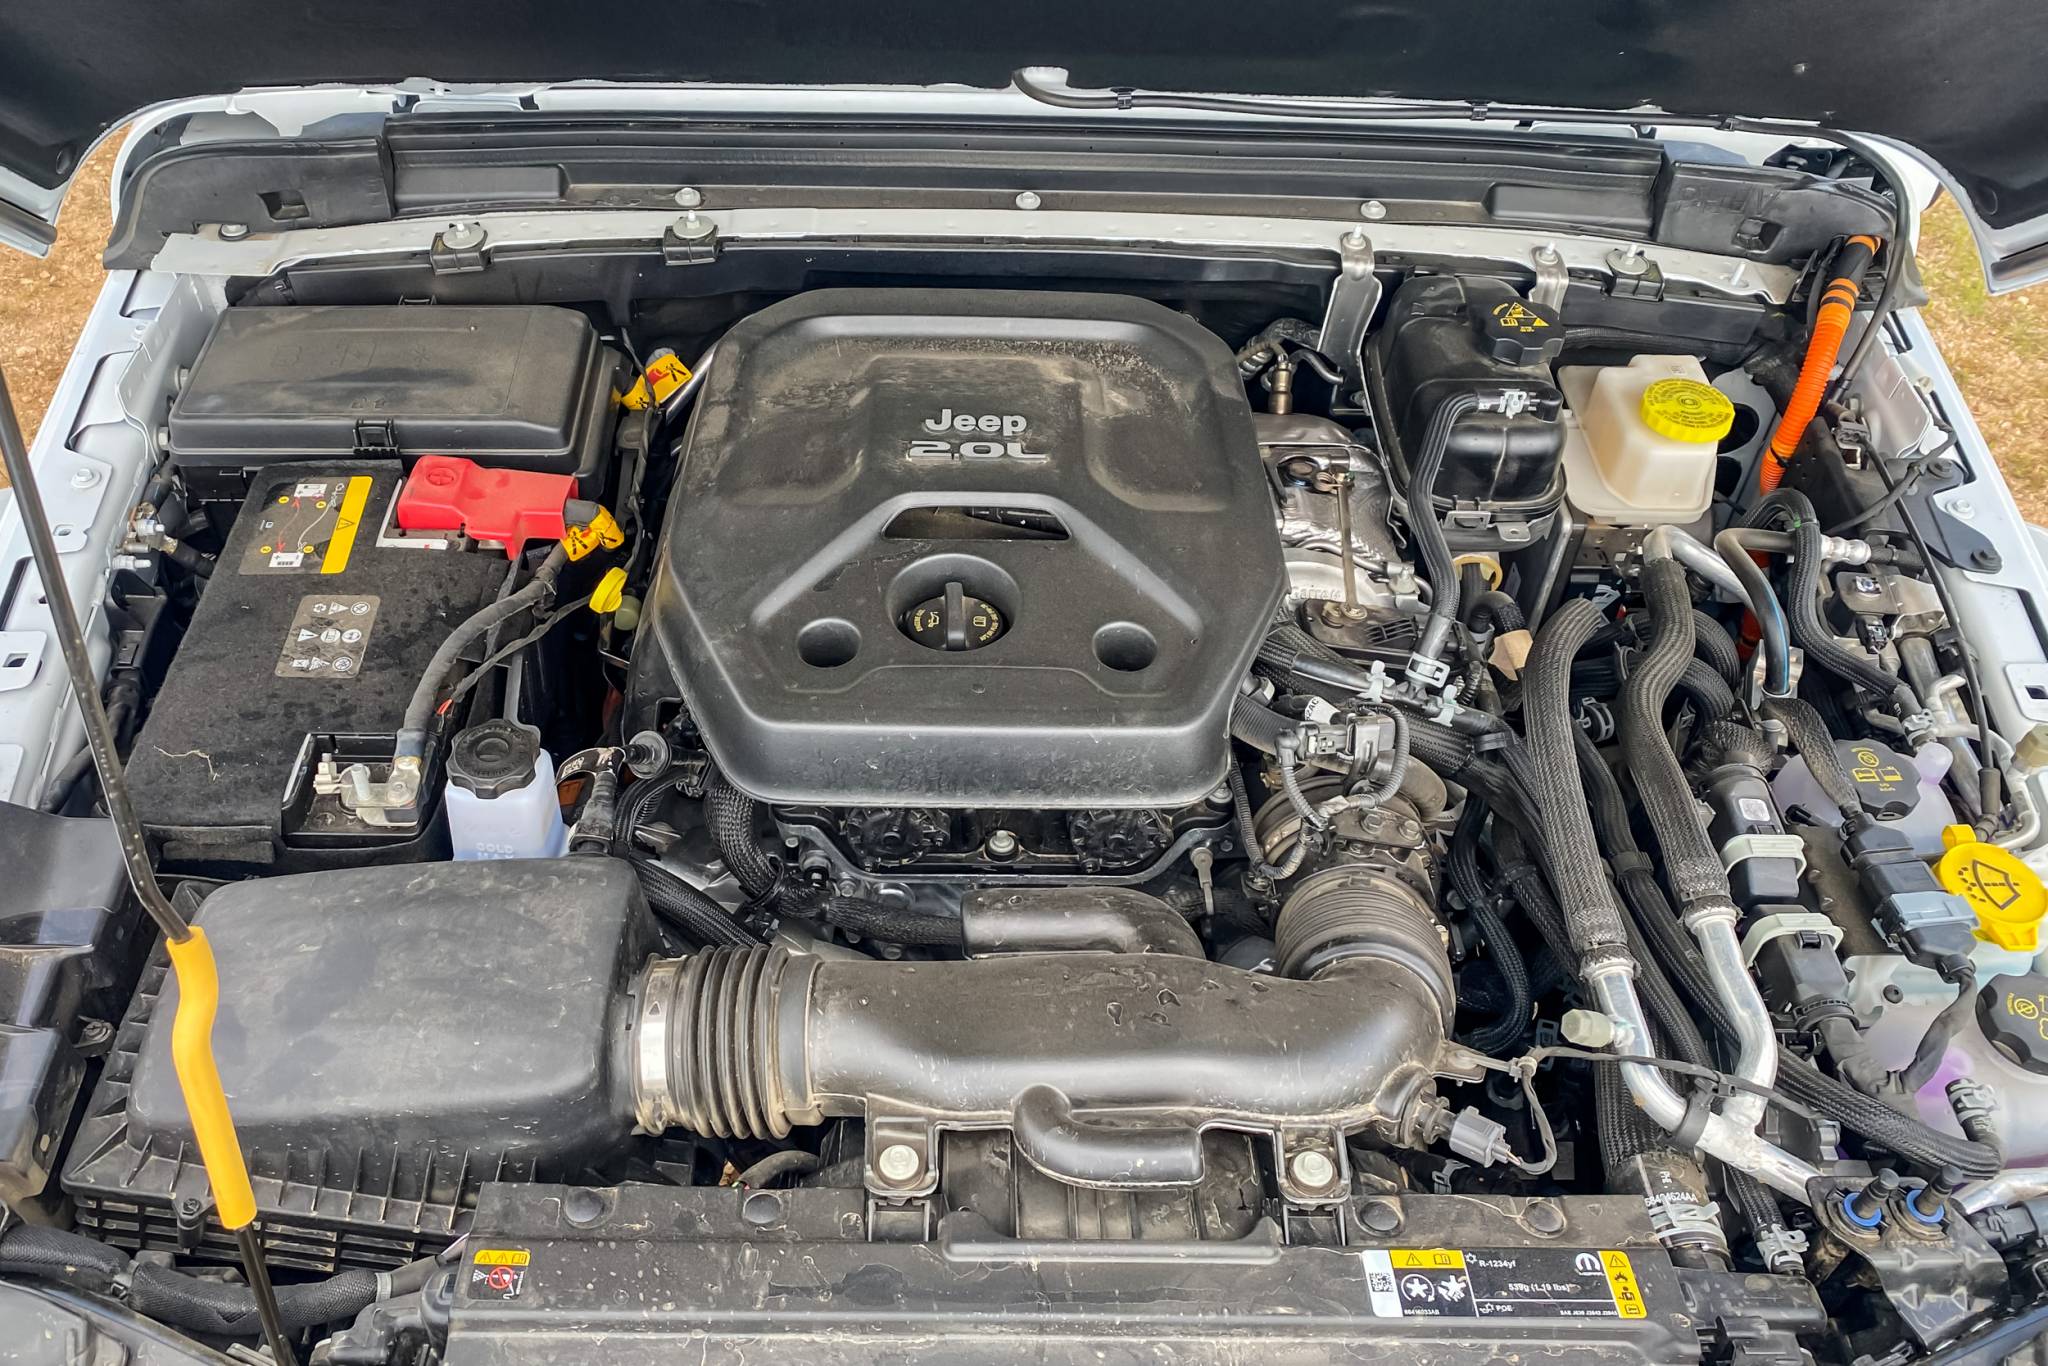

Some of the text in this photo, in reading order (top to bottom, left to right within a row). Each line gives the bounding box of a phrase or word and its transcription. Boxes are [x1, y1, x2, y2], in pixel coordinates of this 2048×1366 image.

[925, 409, 1027, 436] Jeep
[909, 440, 1047, 460] 2.0L
[476, 842, 514, 854] COLD
[1479, 1260, 1516, 1269] R-1234yf
